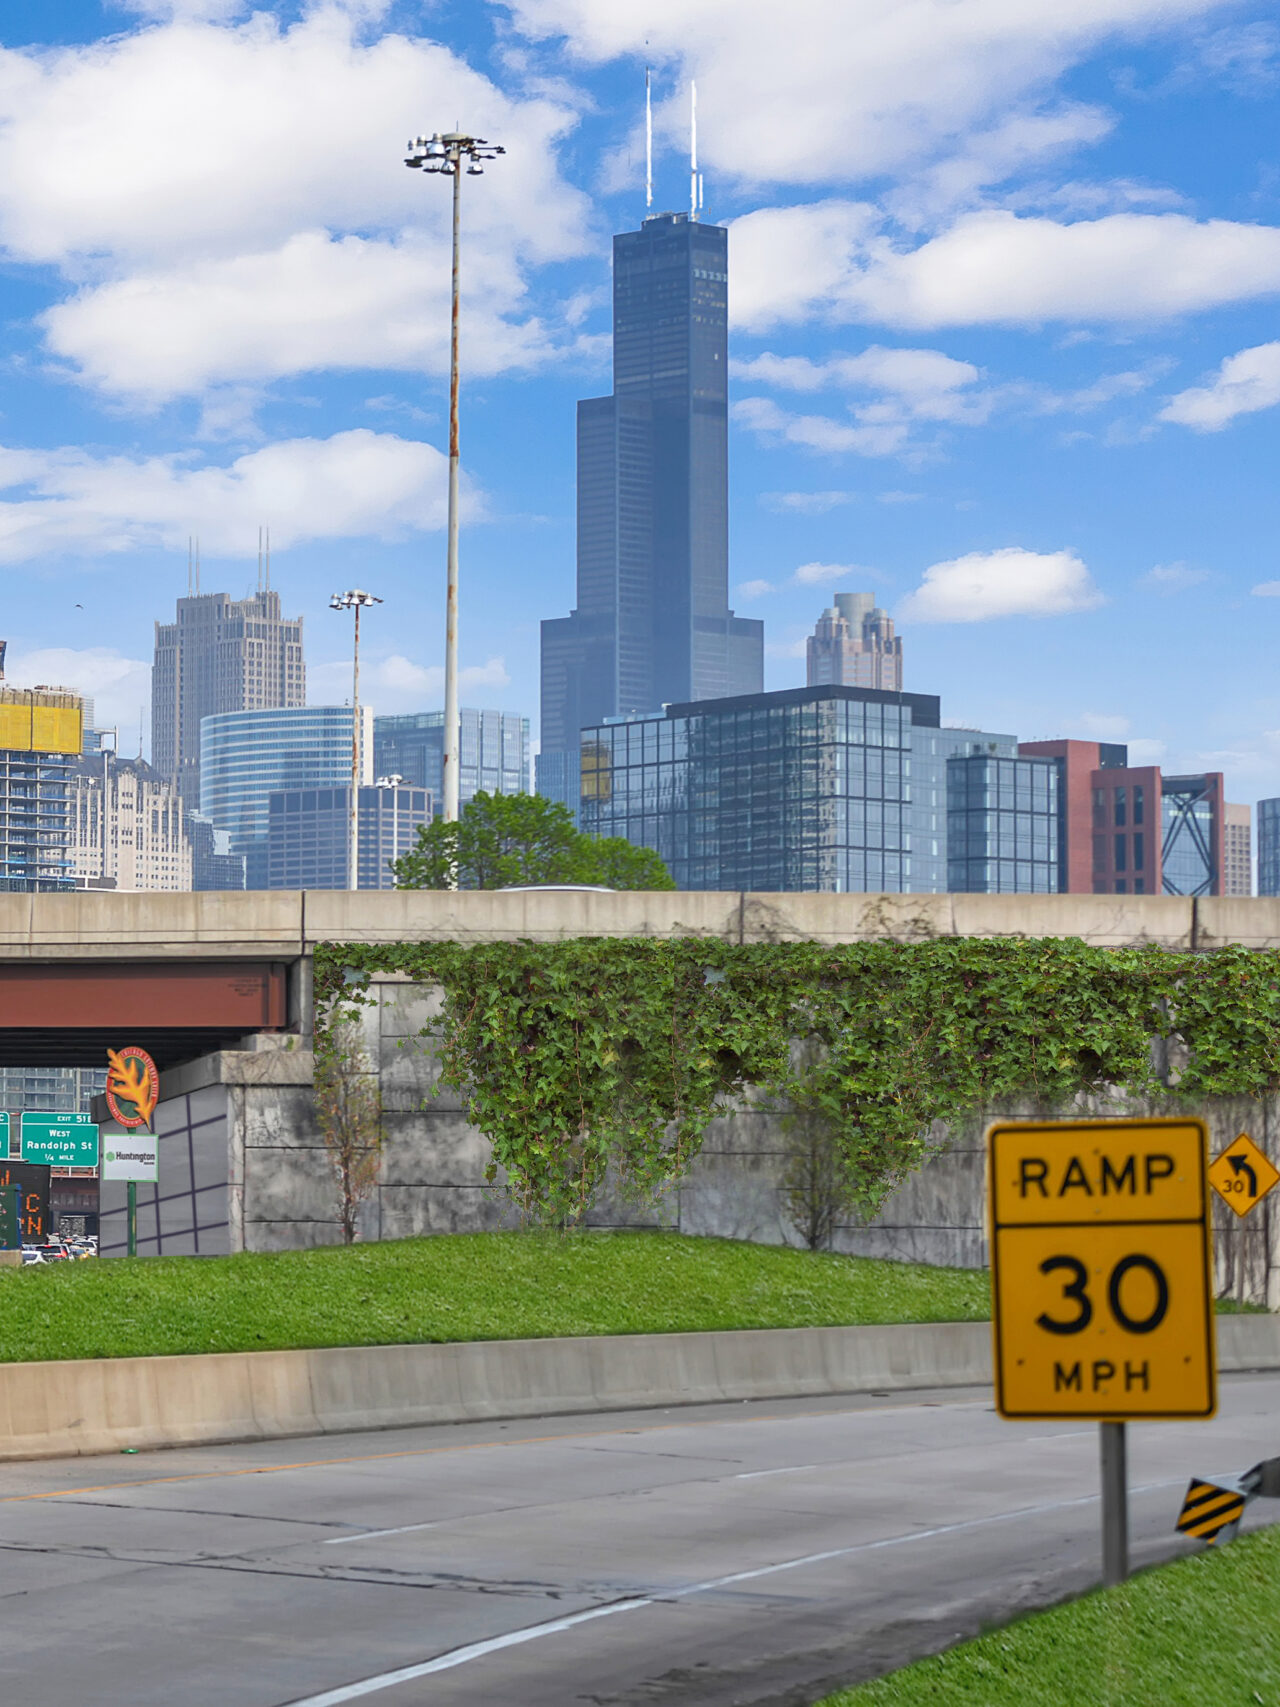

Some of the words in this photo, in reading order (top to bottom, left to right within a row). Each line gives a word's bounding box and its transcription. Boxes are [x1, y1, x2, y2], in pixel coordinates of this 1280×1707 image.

[49, 1129, 71, 1138] WEST
[26, 1140, 76, 1151] Randolph
[81, 1141, 93, 1150] St
[116, 1151, 156, 1163] Huntington
[1019, 1153, 1176, 1199] RAMP
[1223, 1180, 1245, 1194] 30
[1035, 1252, 1171, 1337] 30
[1053, 1358, 1151, 1393] MPH
